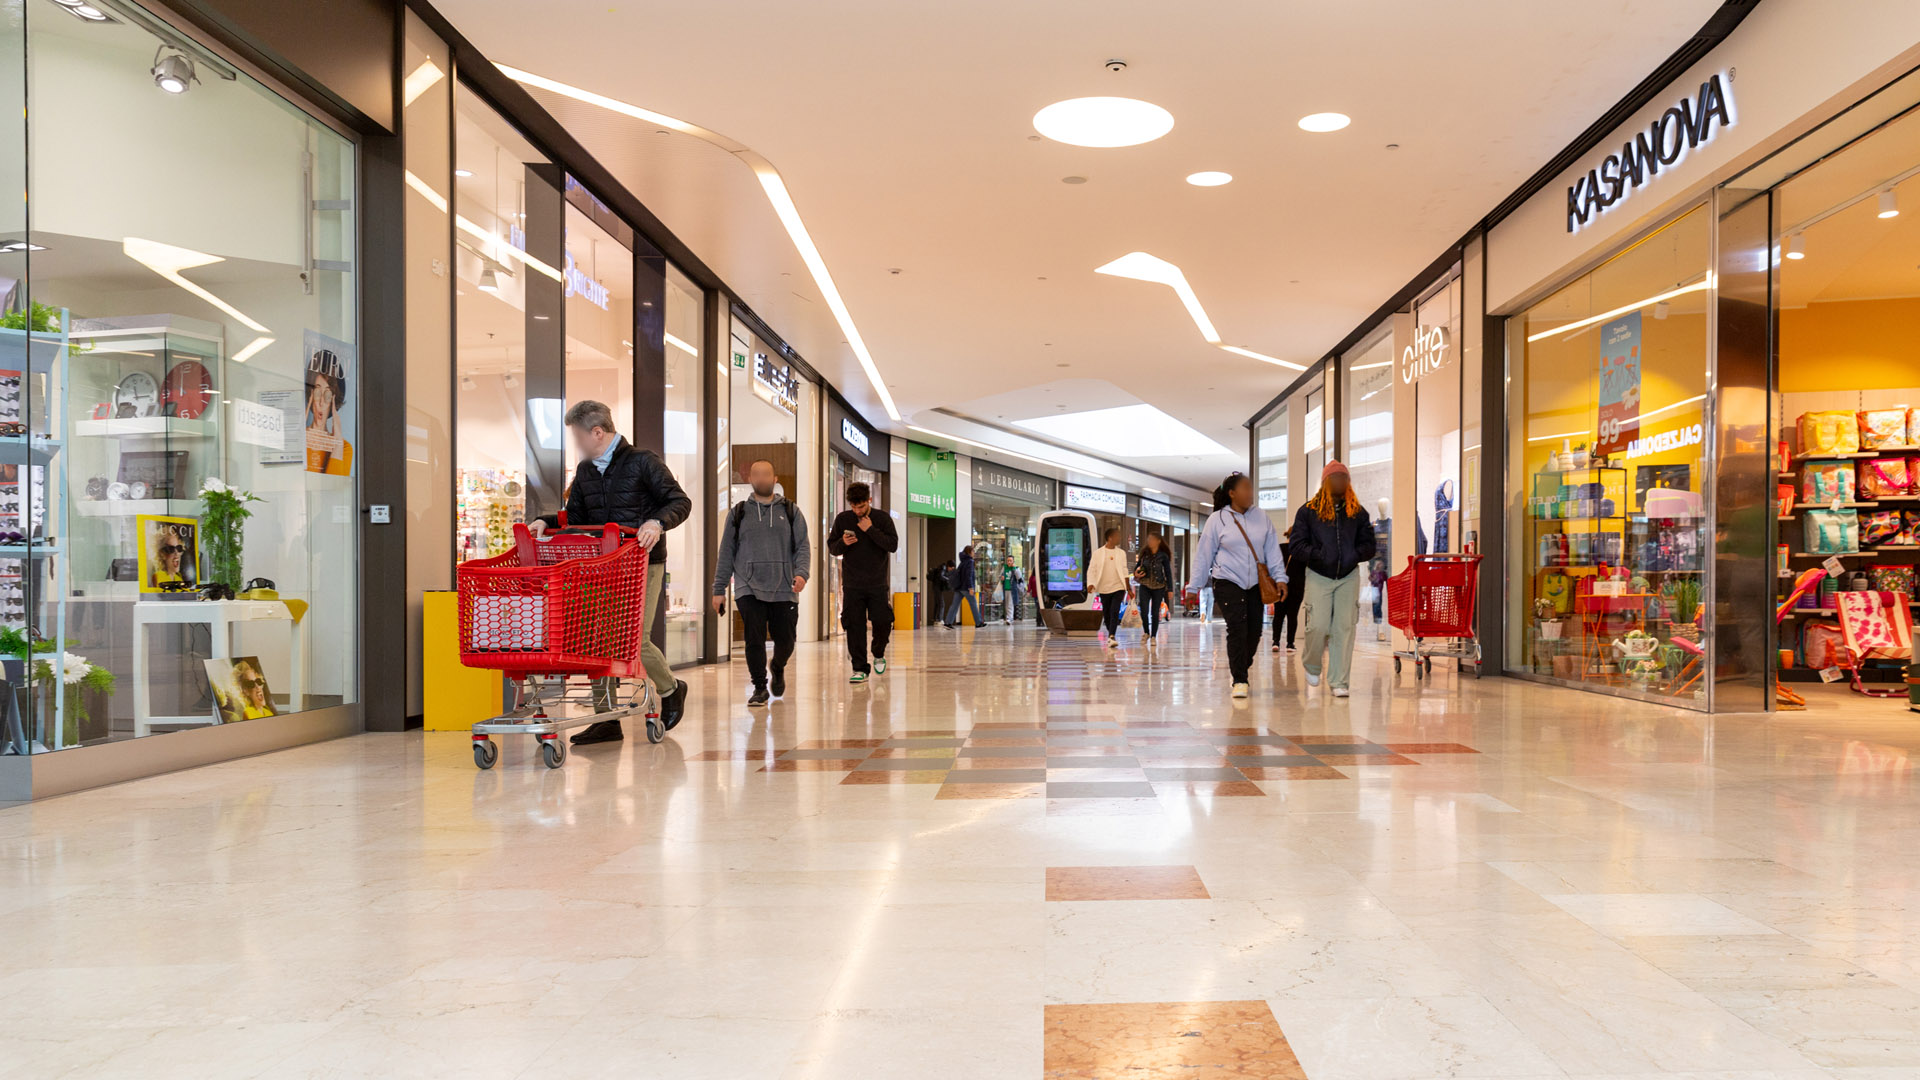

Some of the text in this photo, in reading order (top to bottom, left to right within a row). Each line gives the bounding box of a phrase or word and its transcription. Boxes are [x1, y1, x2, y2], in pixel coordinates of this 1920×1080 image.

[1567, 75, 1730, 233] KASANOVA
[1402, 324, 1444, 385] oltre
[990, 472, 1041, 496] L'ERBOLARIO
[910, 492, 932, 505] TOILETTE
[151, 523, 193, 538] GUCCI
